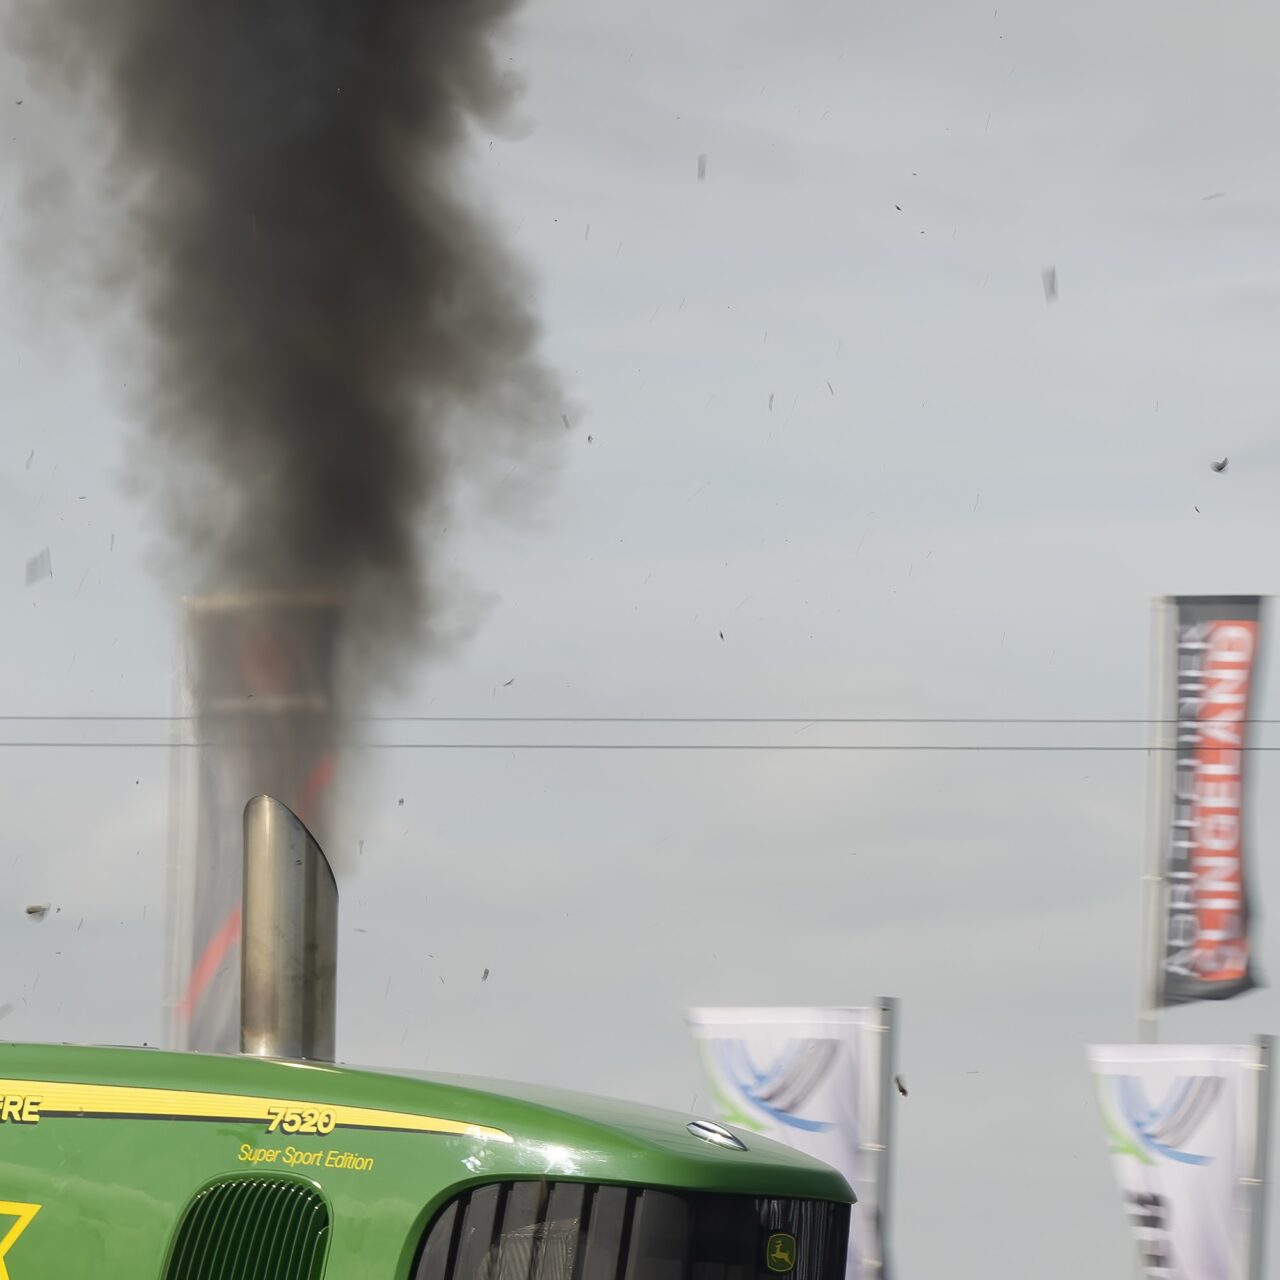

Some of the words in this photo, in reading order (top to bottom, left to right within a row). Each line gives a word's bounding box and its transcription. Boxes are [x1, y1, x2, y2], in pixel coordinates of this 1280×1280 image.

[267, 1107, 337, 1134] 7520
[238, 1144, 281, 1165] Super
[282, 1146, 322, 1167] Sport
[324, 1150, 374, 1171] Edition
